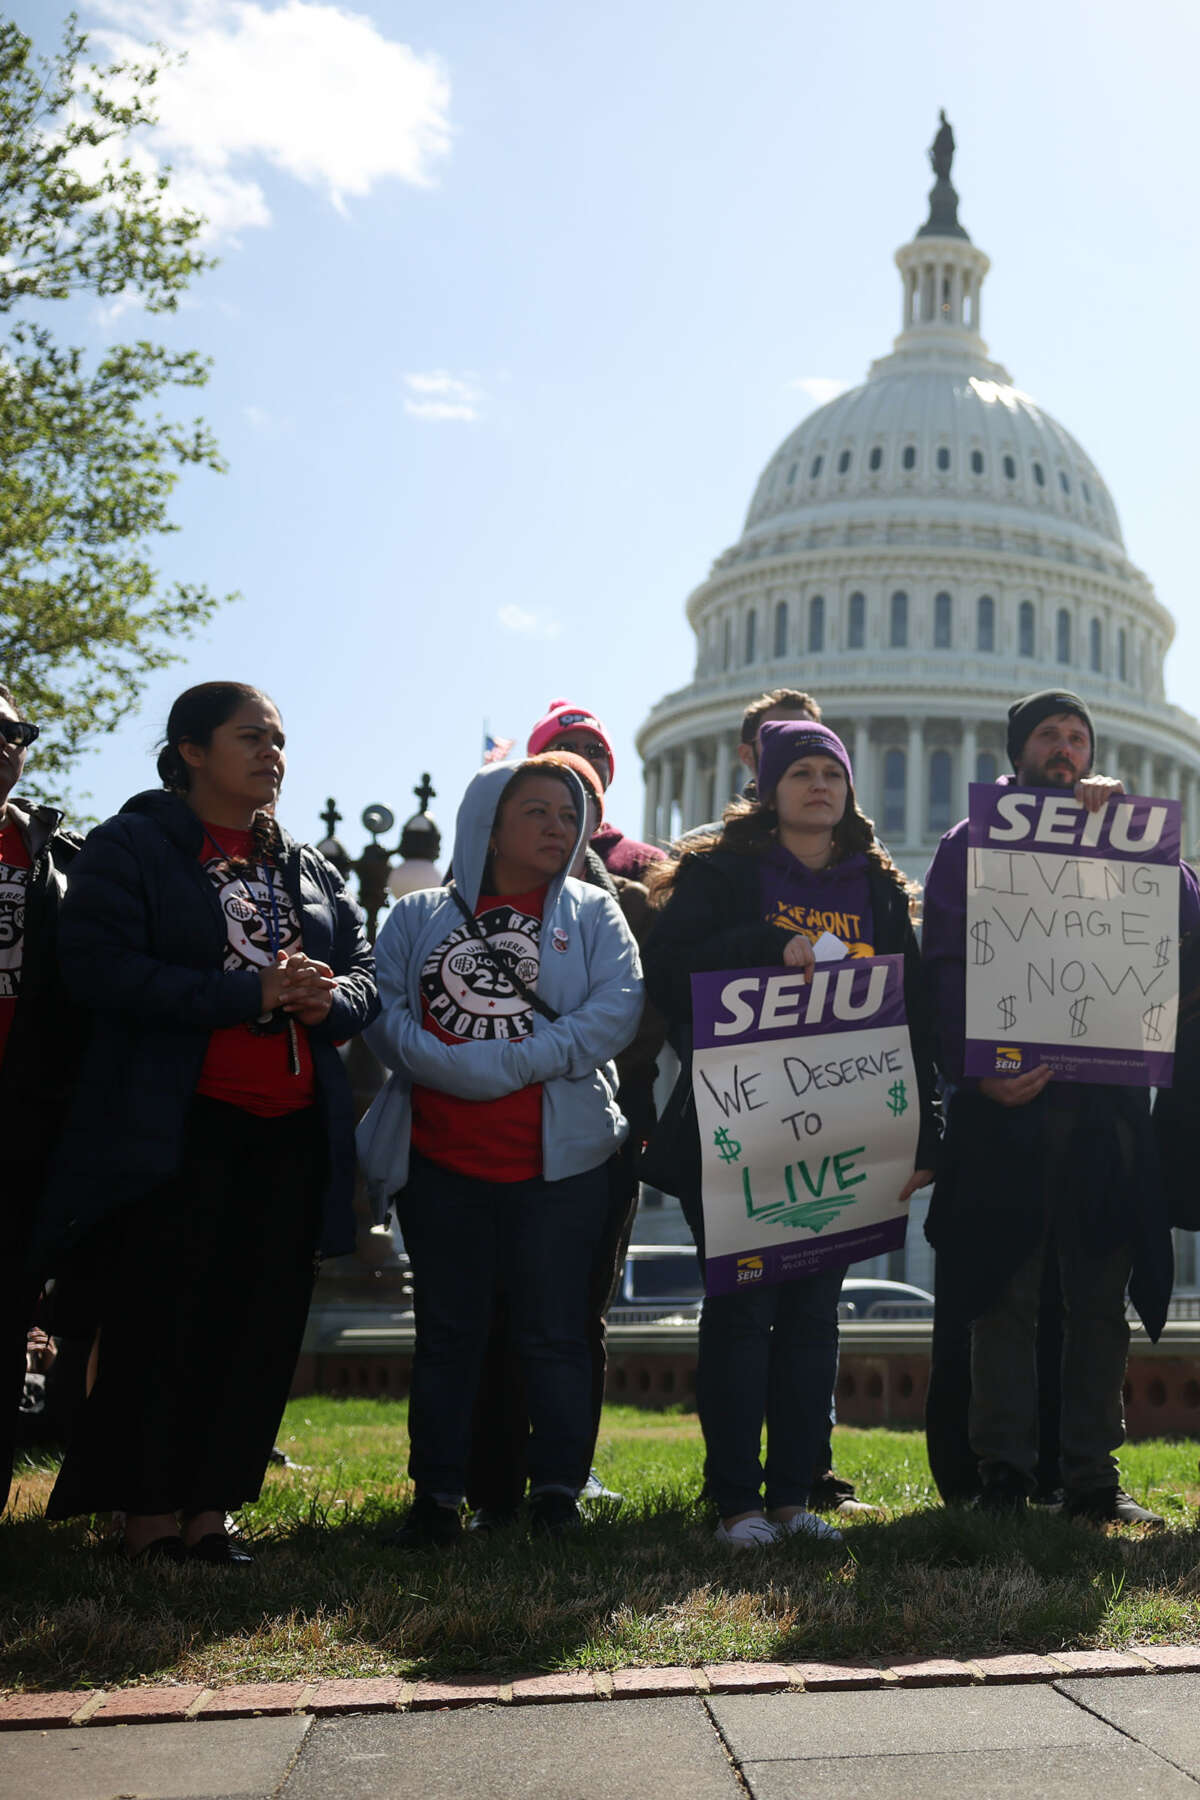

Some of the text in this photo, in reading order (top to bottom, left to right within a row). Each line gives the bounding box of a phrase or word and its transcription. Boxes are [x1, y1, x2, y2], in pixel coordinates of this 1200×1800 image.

[988, 792, 1168, 853] SEIU
[973, 848, 1160, 901] LIVING
[992, 906, 1150, 946] WAGE
[471, 967, 514, 994] 25
[477, 955, 516, 968] LOL
[1027, 958, 1164, 1004] NOW
[430, 992, 534, 1040] PROGRE
[713, 964, 889, 1037] SEIU
[699, 1048, 904, 1119] WE DESERVE
[995, 1060, 1022, 1070] SEIU
[886, 1079, 908, 1117] $
[713, 1125, 742, 1165] $
[781, 1110, 822, 1142] TO
[742, 1145, 867, 1219] LIVE
[736, 1268, 764, 1282] SEIU
